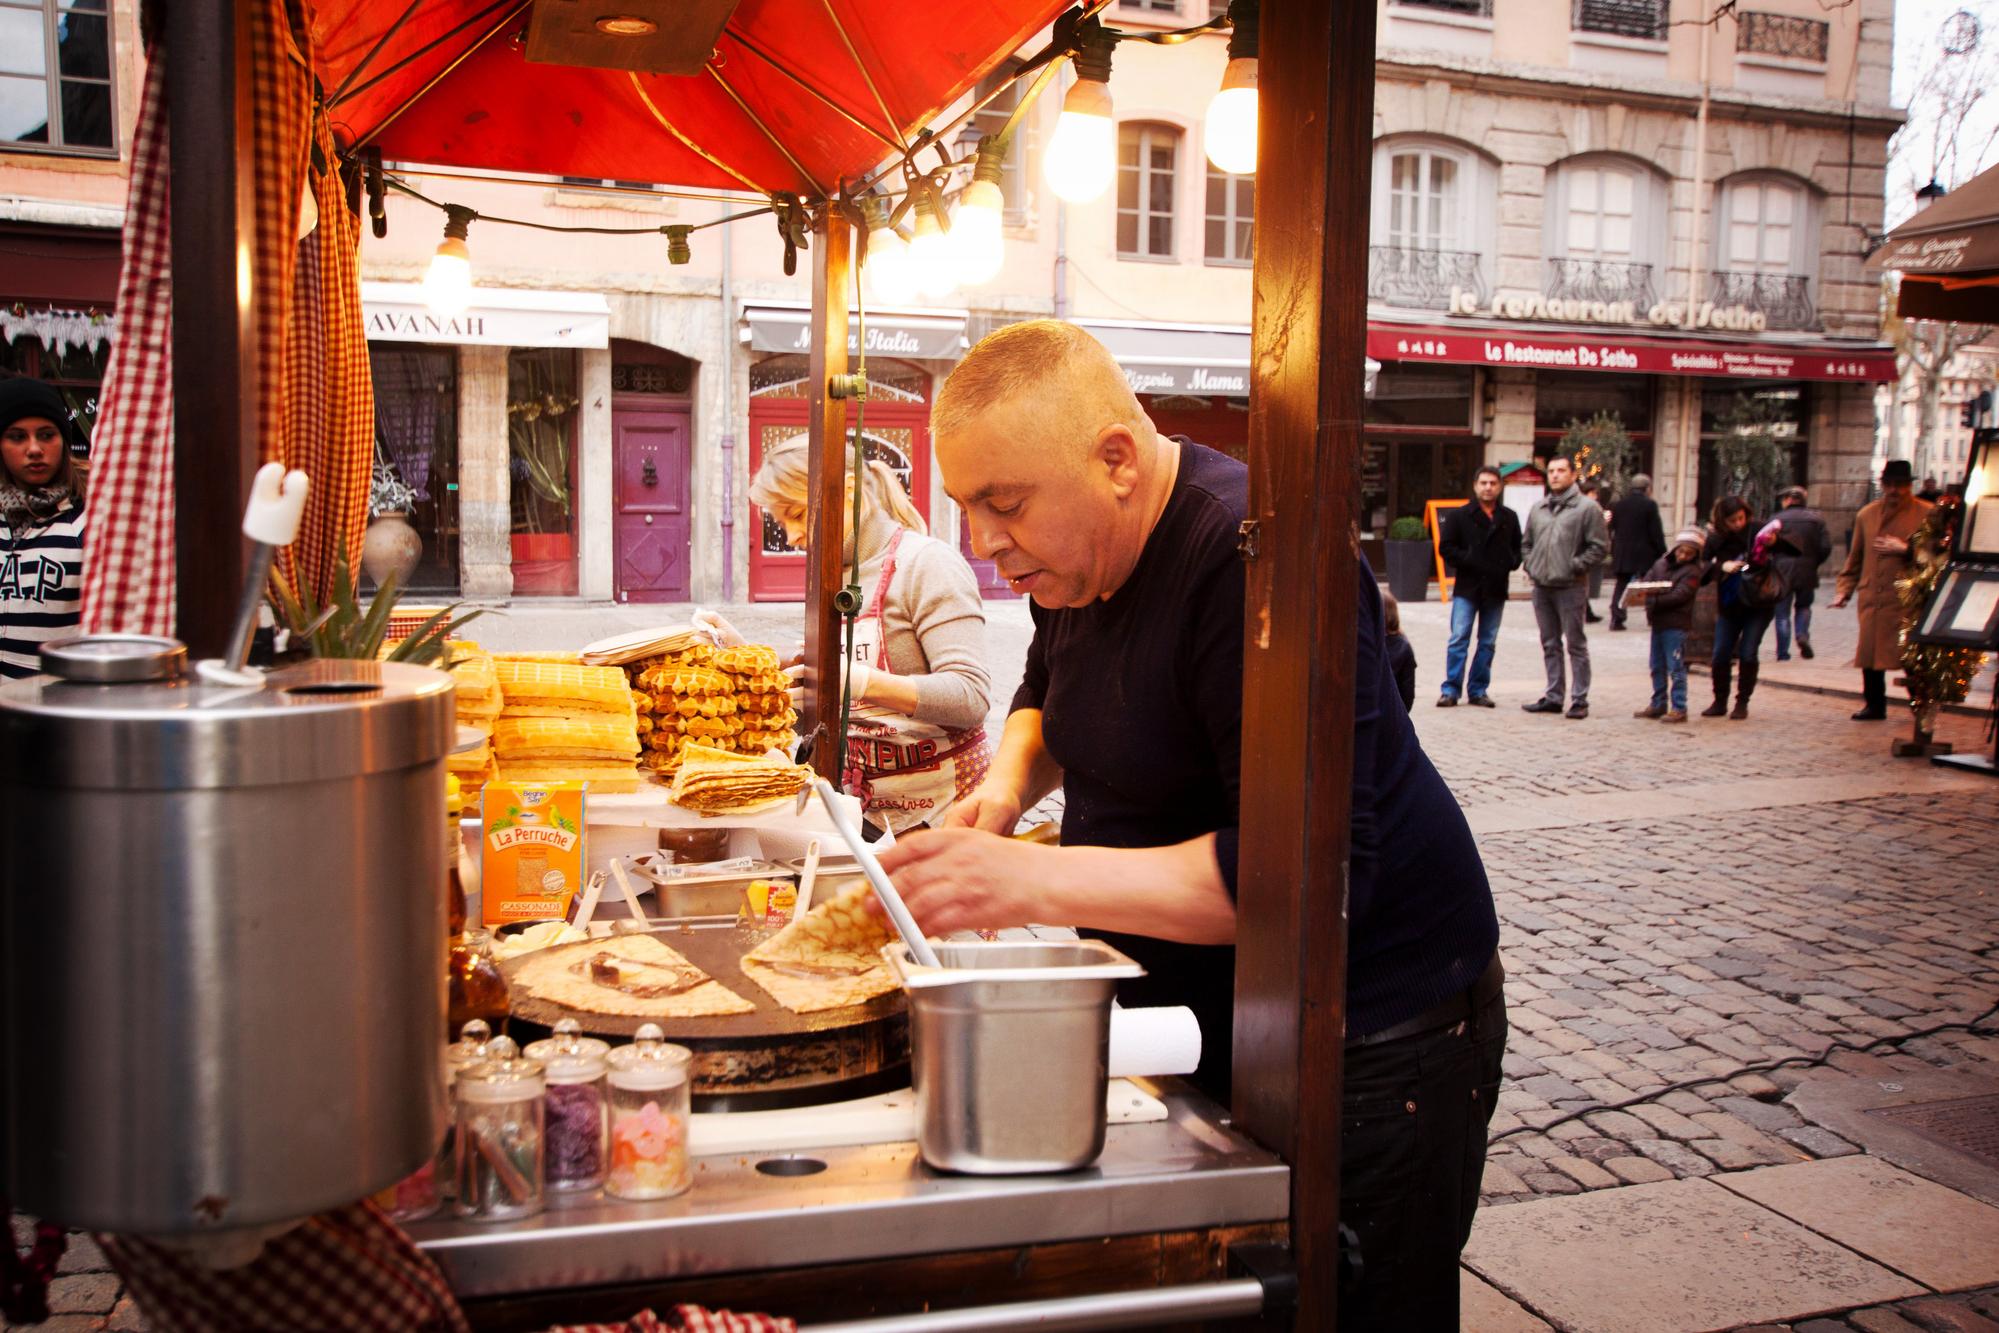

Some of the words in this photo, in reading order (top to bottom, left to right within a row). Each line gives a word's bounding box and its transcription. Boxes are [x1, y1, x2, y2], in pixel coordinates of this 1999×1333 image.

[865, 328, 920, 353] Italia
[1485, 340, 1502, 361] Le
[1504, 342, 1577, 365] Restaurant
[1578, 346, 1598, 366] De
[1600, 347, 1638, 368] Setha
[1187, 368, 1244, 390] Mama
[496, 832, 512, 846] La
[514, 828, 569, 847] Perruche
